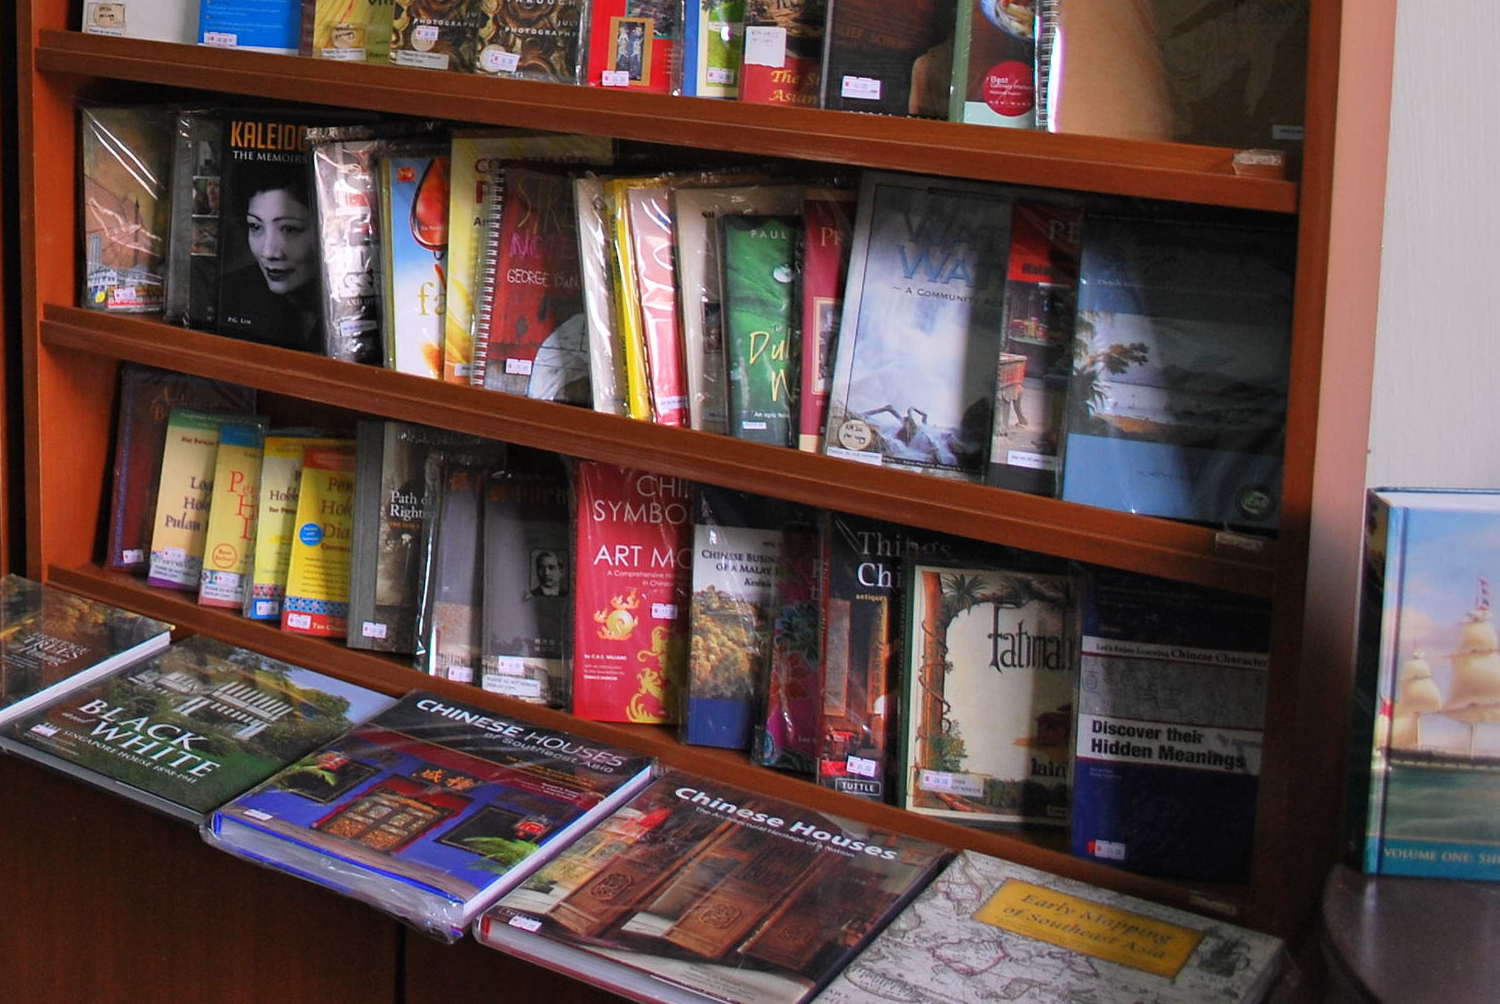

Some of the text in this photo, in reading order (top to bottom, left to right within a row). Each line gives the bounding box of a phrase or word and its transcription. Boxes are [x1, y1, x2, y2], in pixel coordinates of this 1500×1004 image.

[233, 150, 255, 161] THE
[390, 490, 417, 506] Path
[593, 544, 642, 567] ART
[701, 548, 743, 562] CHINESE
[739, 564, 773, 575] MALAY
[1170, 649, 1214, 662] Chinese
[77, 698, 209, 752] BLACK
[416, 698, 629, 768] CHINESE HOUSES
[1092, 720, 1206, 745] Discover their
[89, 721, 222, 778] WHITE
[501, 737, 580, 765] Southeast
[579, 758, 615, 774] Asia
[1091, 738, 1248, 771] Hidden Meanings
[841, 781, 875, 793] TUTTLE
[675, 787, 899, 861] Chinese Houses
[767, 827, 806, 843] Heritage
[1383, 846, 1438, 863] VOLUME
[1021, 893, 1173, 946] Early Mapping
[1002, 906, 1168, 960] of Southeast Asia
